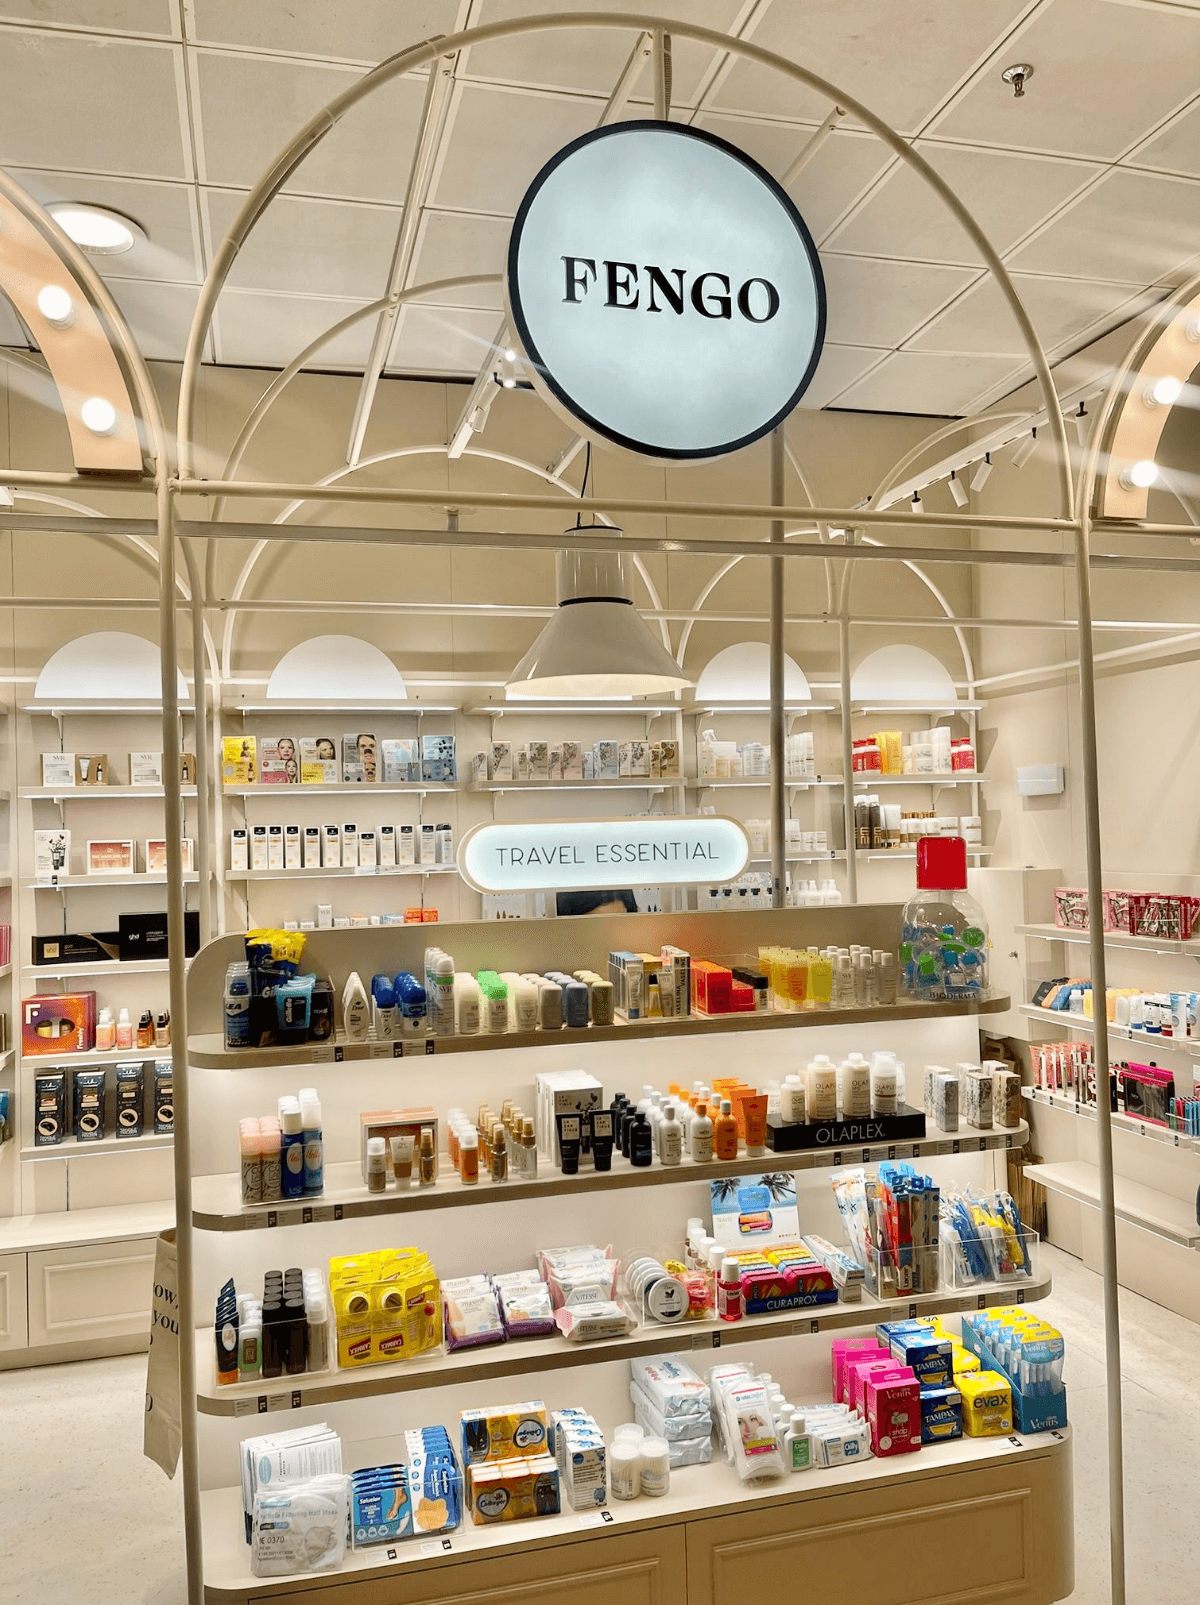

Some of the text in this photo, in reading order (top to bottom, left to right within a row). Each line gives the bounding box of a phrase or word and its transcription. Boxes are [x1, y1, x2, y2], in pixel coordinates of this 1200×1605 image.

[561, 255, 780, 324] FENGO
[495, 842, 719, 866] TRAVEL ESSENTIAL
[929, 992, 977, 1000] BIODERMA
[815, 1122, 884, 1144] OLAPLEX
[153, 1282, 179, 1310] ow,
[575, 1292, 598, 1302] VITESSE
[766, 1294, 818, 1310] CURAPROX
[916, 1358, 946, 1371] TAMPAX
[973, 1394, 1009, 1409] evax
[925, 1408, 955, 1423] TAMPAX
[1031, 1419, 1058, 1429] Venus
[267, 1536, 285, 1544] 0370
